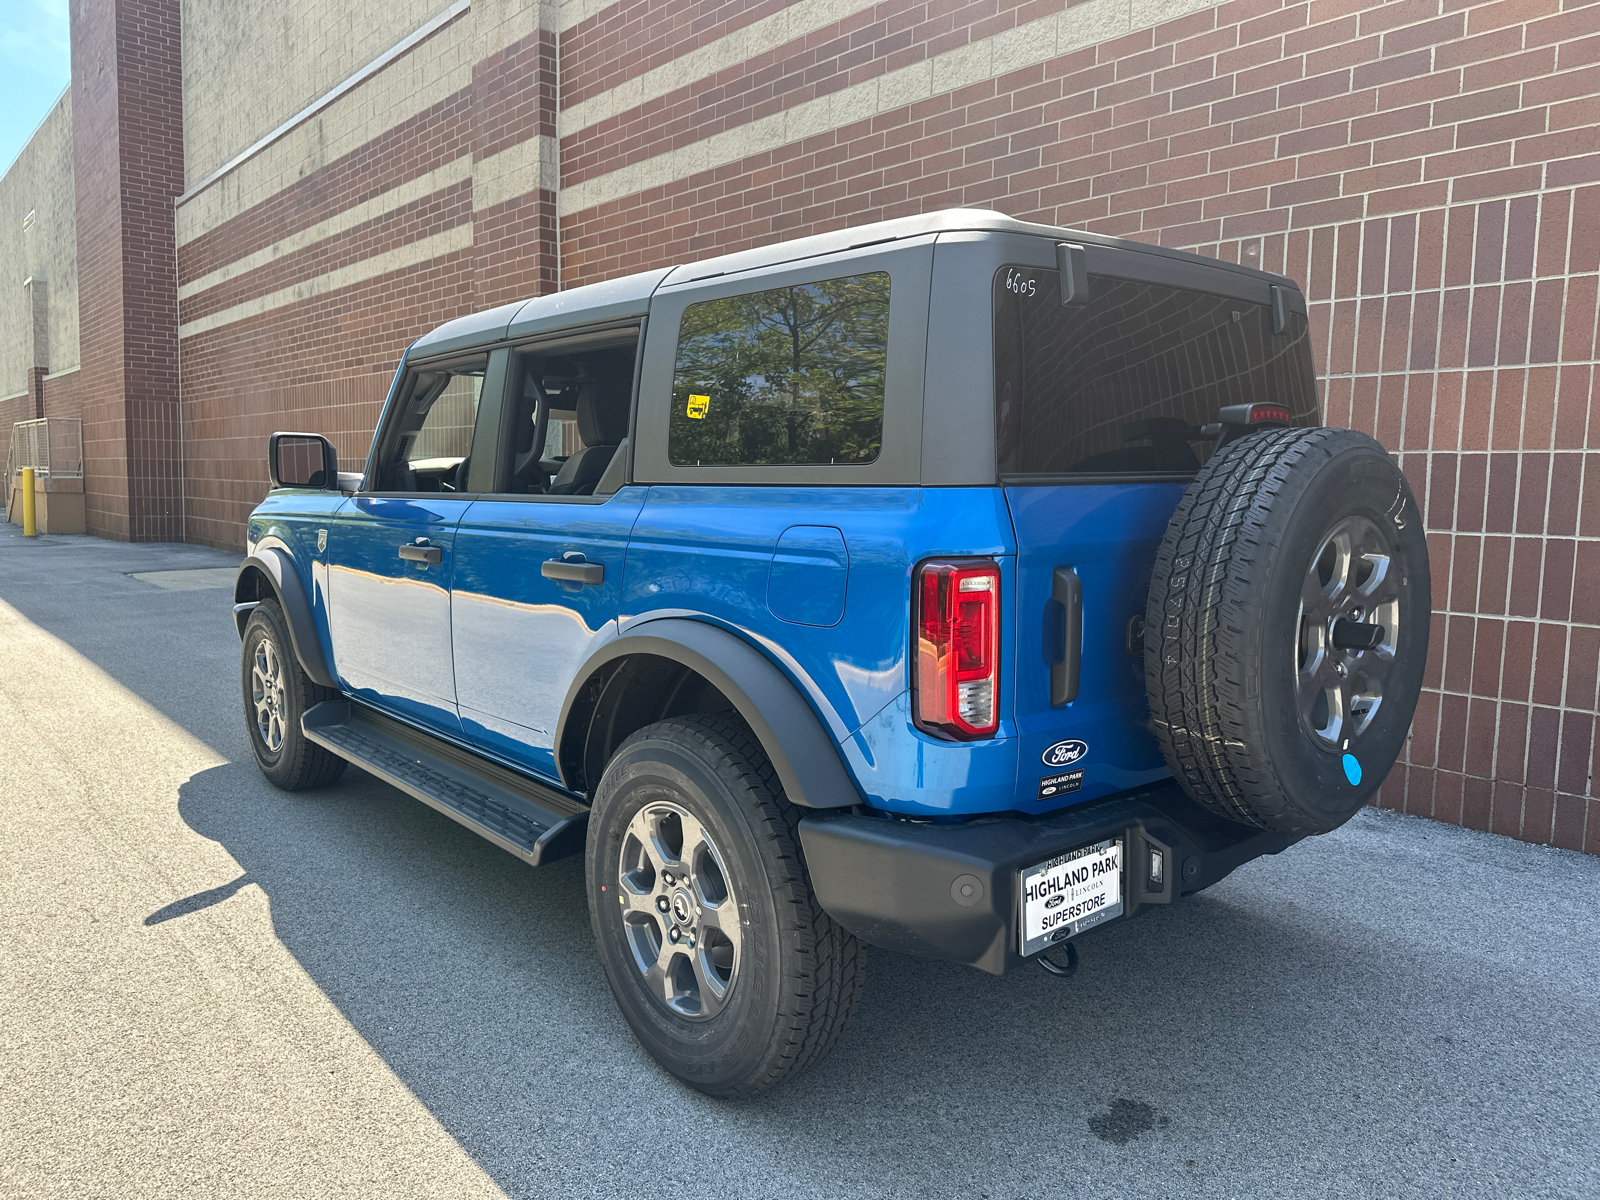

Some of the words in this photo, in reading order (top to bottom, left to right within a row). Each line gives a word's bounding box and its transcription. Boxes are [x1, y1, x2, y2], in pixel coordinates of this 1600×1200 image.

[1006, 268, 1036, 297] 6605
[1052, 744, 1081, 763] Ford
[1041, 775, 1069, 787] HIGHLAND
[1069, 771, 1083, 781] PARK
[1058, 782, 1079, 791] LINCOLN
[1026, 866, 1089, 903] HIGHLAND
[1092, 854, 1118, 878] PARK
[1075, 880, 1104, 897] LINCOLN
[1041, 892, 1106, 930] SUPERSTORE
